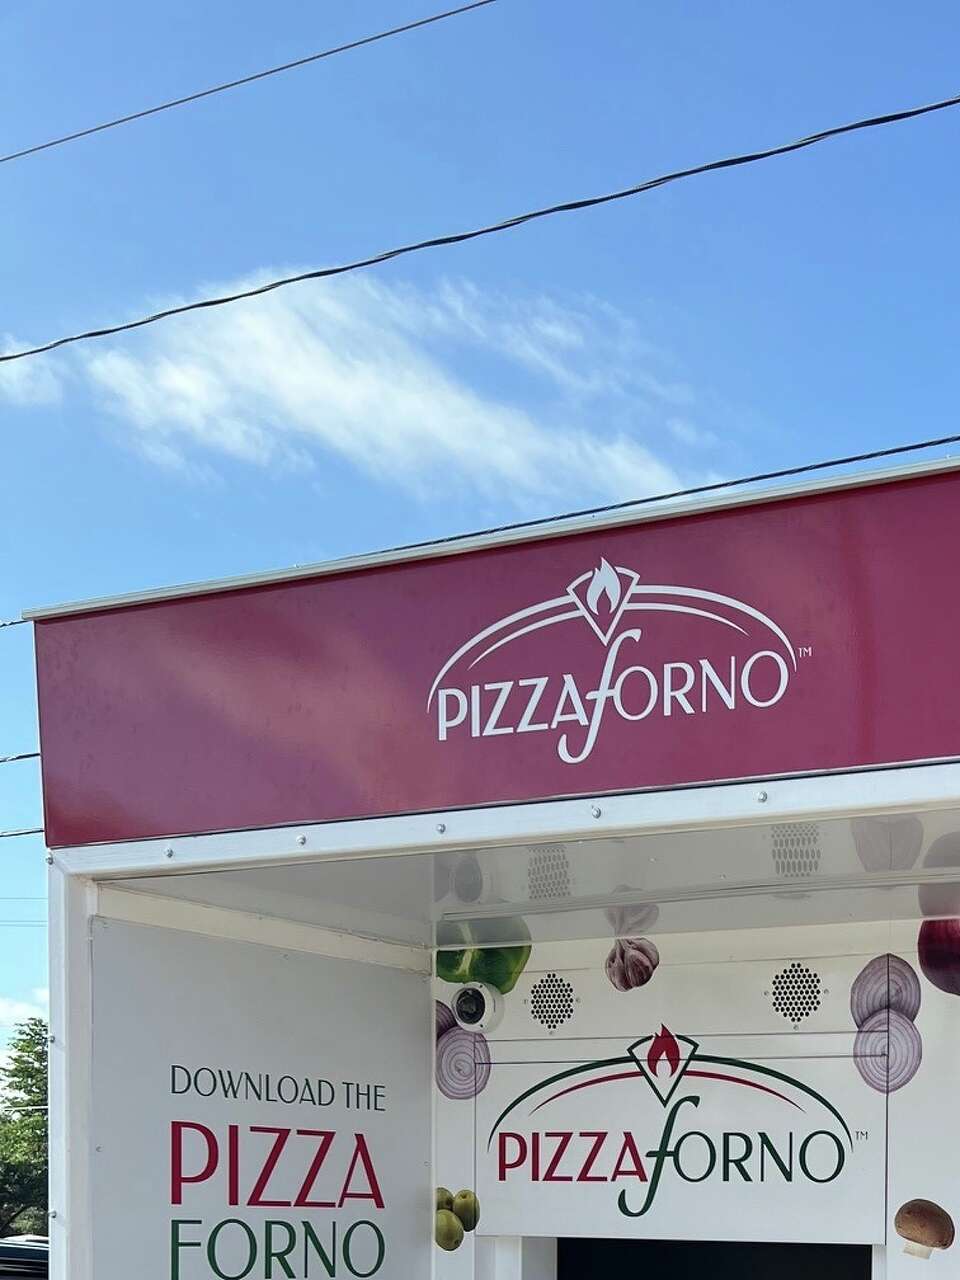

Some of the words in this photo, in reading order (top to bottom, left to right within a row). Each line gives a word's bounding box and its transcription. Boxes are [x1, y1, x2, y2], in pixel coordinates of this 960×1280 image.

[170, 1064, 336, 1107] DOWNLOAD
[342, 1081, 387, 1112] THE
[170, 1120, 386, 1209] PIZZA
